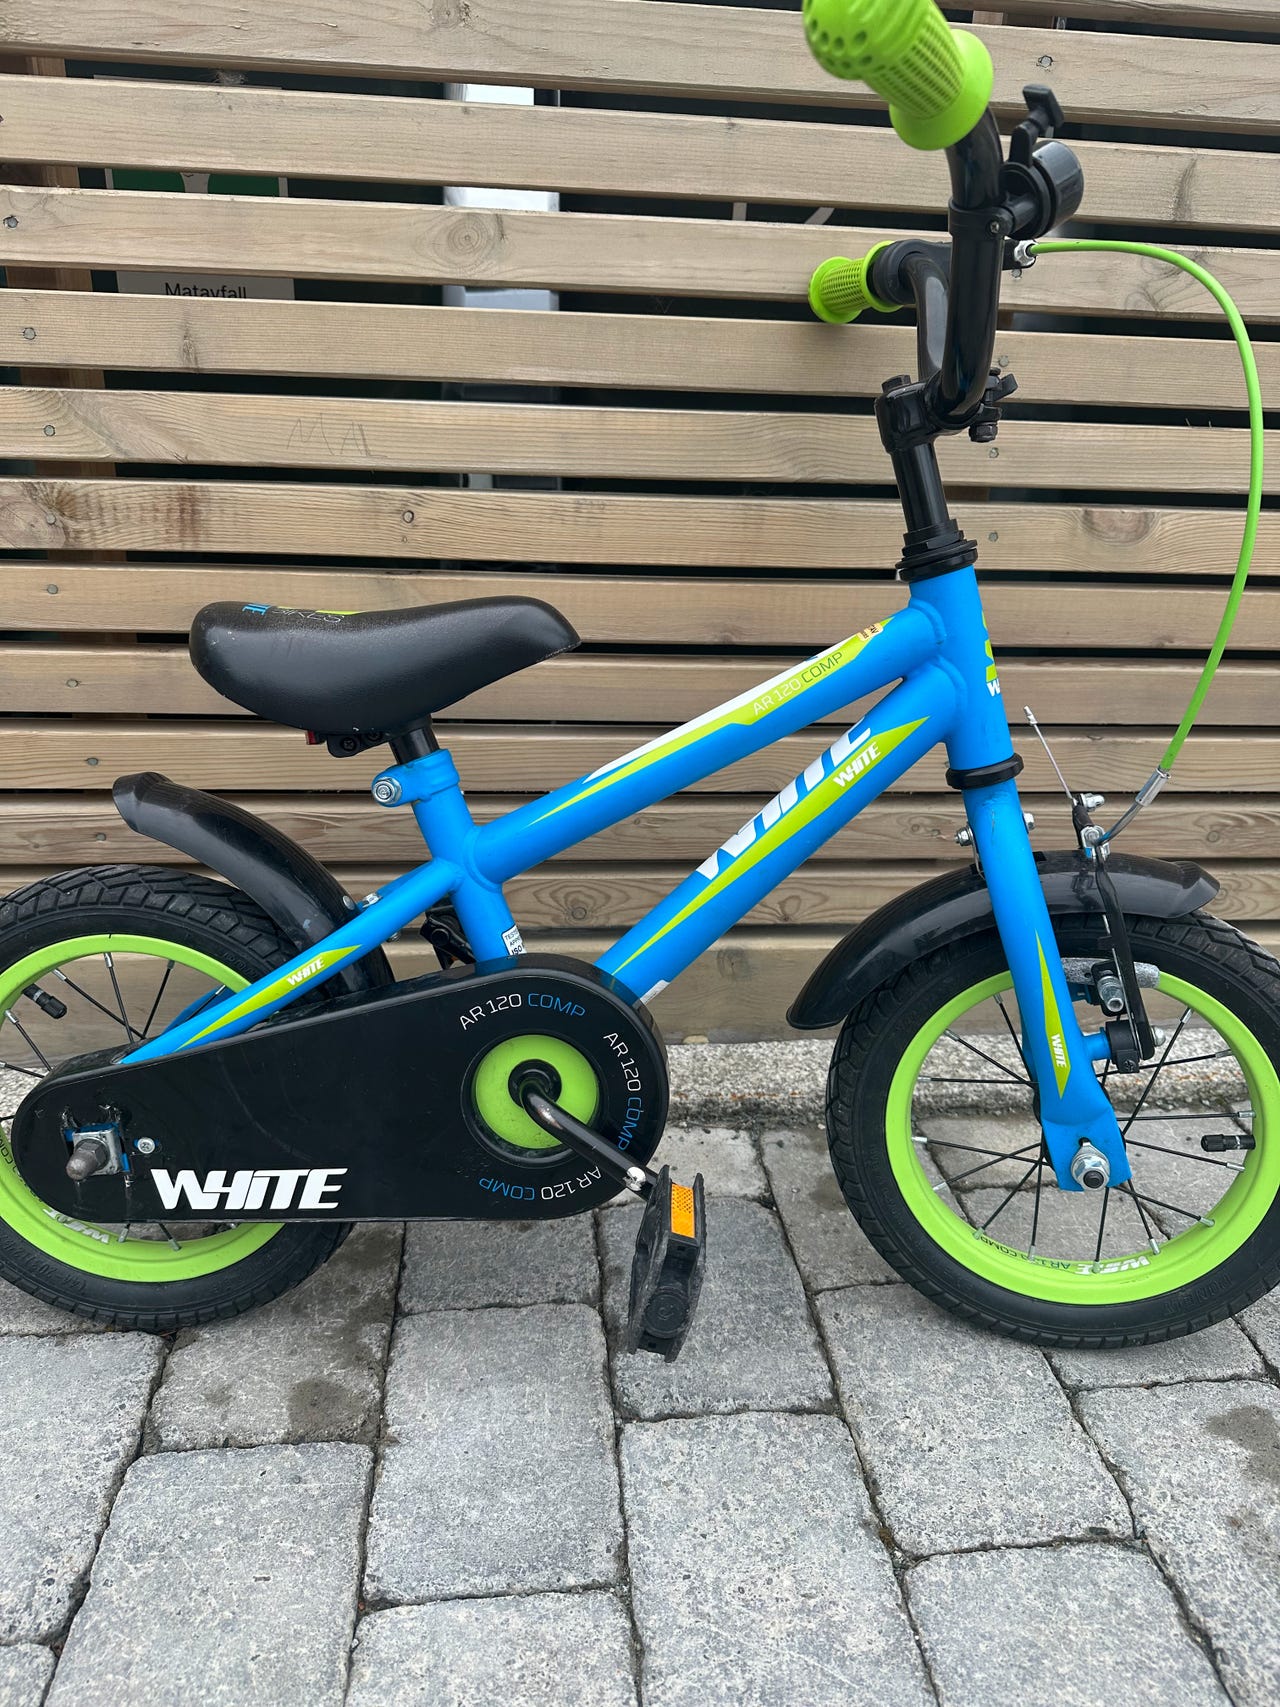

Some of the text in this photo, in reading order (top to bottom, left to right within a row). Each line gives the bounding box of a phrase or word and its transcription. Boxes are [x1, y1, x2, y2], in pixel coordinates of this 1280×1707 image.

[753, 651, 843, 716] AR 120 COMP
[833, 741, 882, 788] WHITE
[286, 956, 325, 986] WHITE
[459, 993, 586, 1031] AR 120 COMP
[1050, 1033, 1067, 1068] WHITE
[603, 1032, 642, 1151] AR 120 COMP
[150, 1167, 349, 1210] WHITE
[479, 1166, 602, 1201] AR 120 COMP
